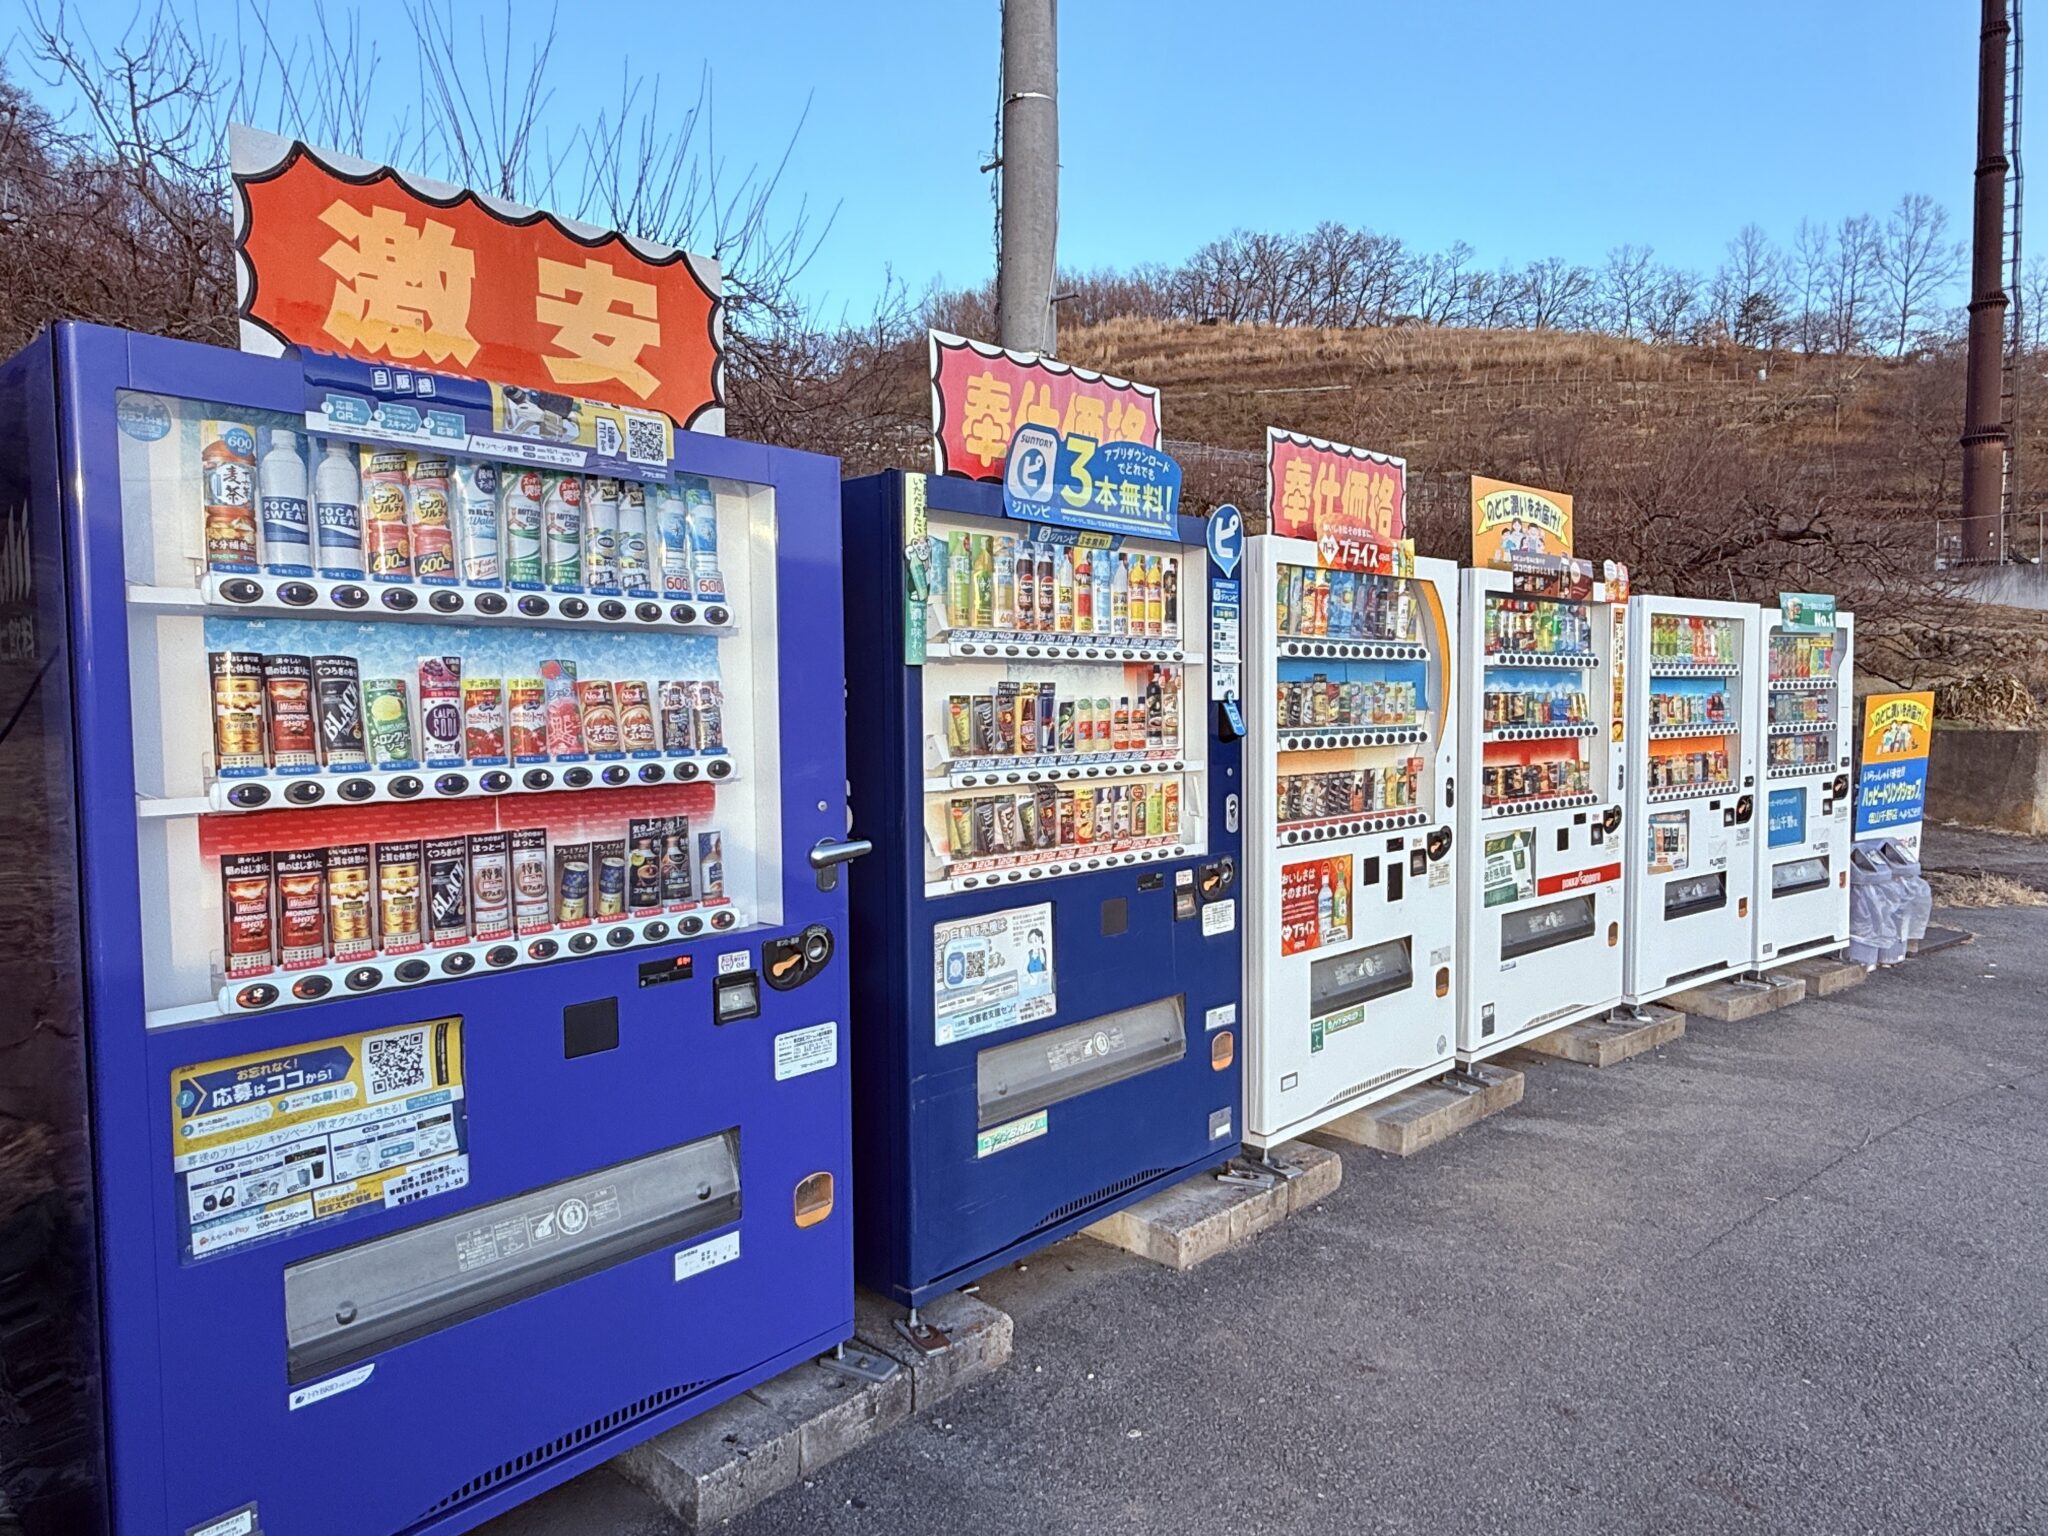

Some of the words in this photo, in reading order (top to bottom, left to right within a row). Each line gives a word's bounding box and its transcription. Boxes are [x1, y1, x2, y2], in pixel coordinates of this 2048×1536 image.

[228, 436, 253, 450] 600
[1020, 433, 1054, 449] SUNTORY
[1104, 447, 1171, 474] アプリダウンロード
[1117, 462, 1156, 482] でどれでも
[223, 466, 244, 504] 麦茶
[1281, 456, 1395, 538] 奉仕価格
[1486, 494, 1562, 533] のどに潤いをお届け!
[420, 556, 445, 574] 600
[1339, 539, 1379, 568] プライス
[1814, 611, 1834, 628] No.1
[236, 1057, 299, 1081] お忘れなく!
[211, 1068, 333, 1108] 応募はココから!
